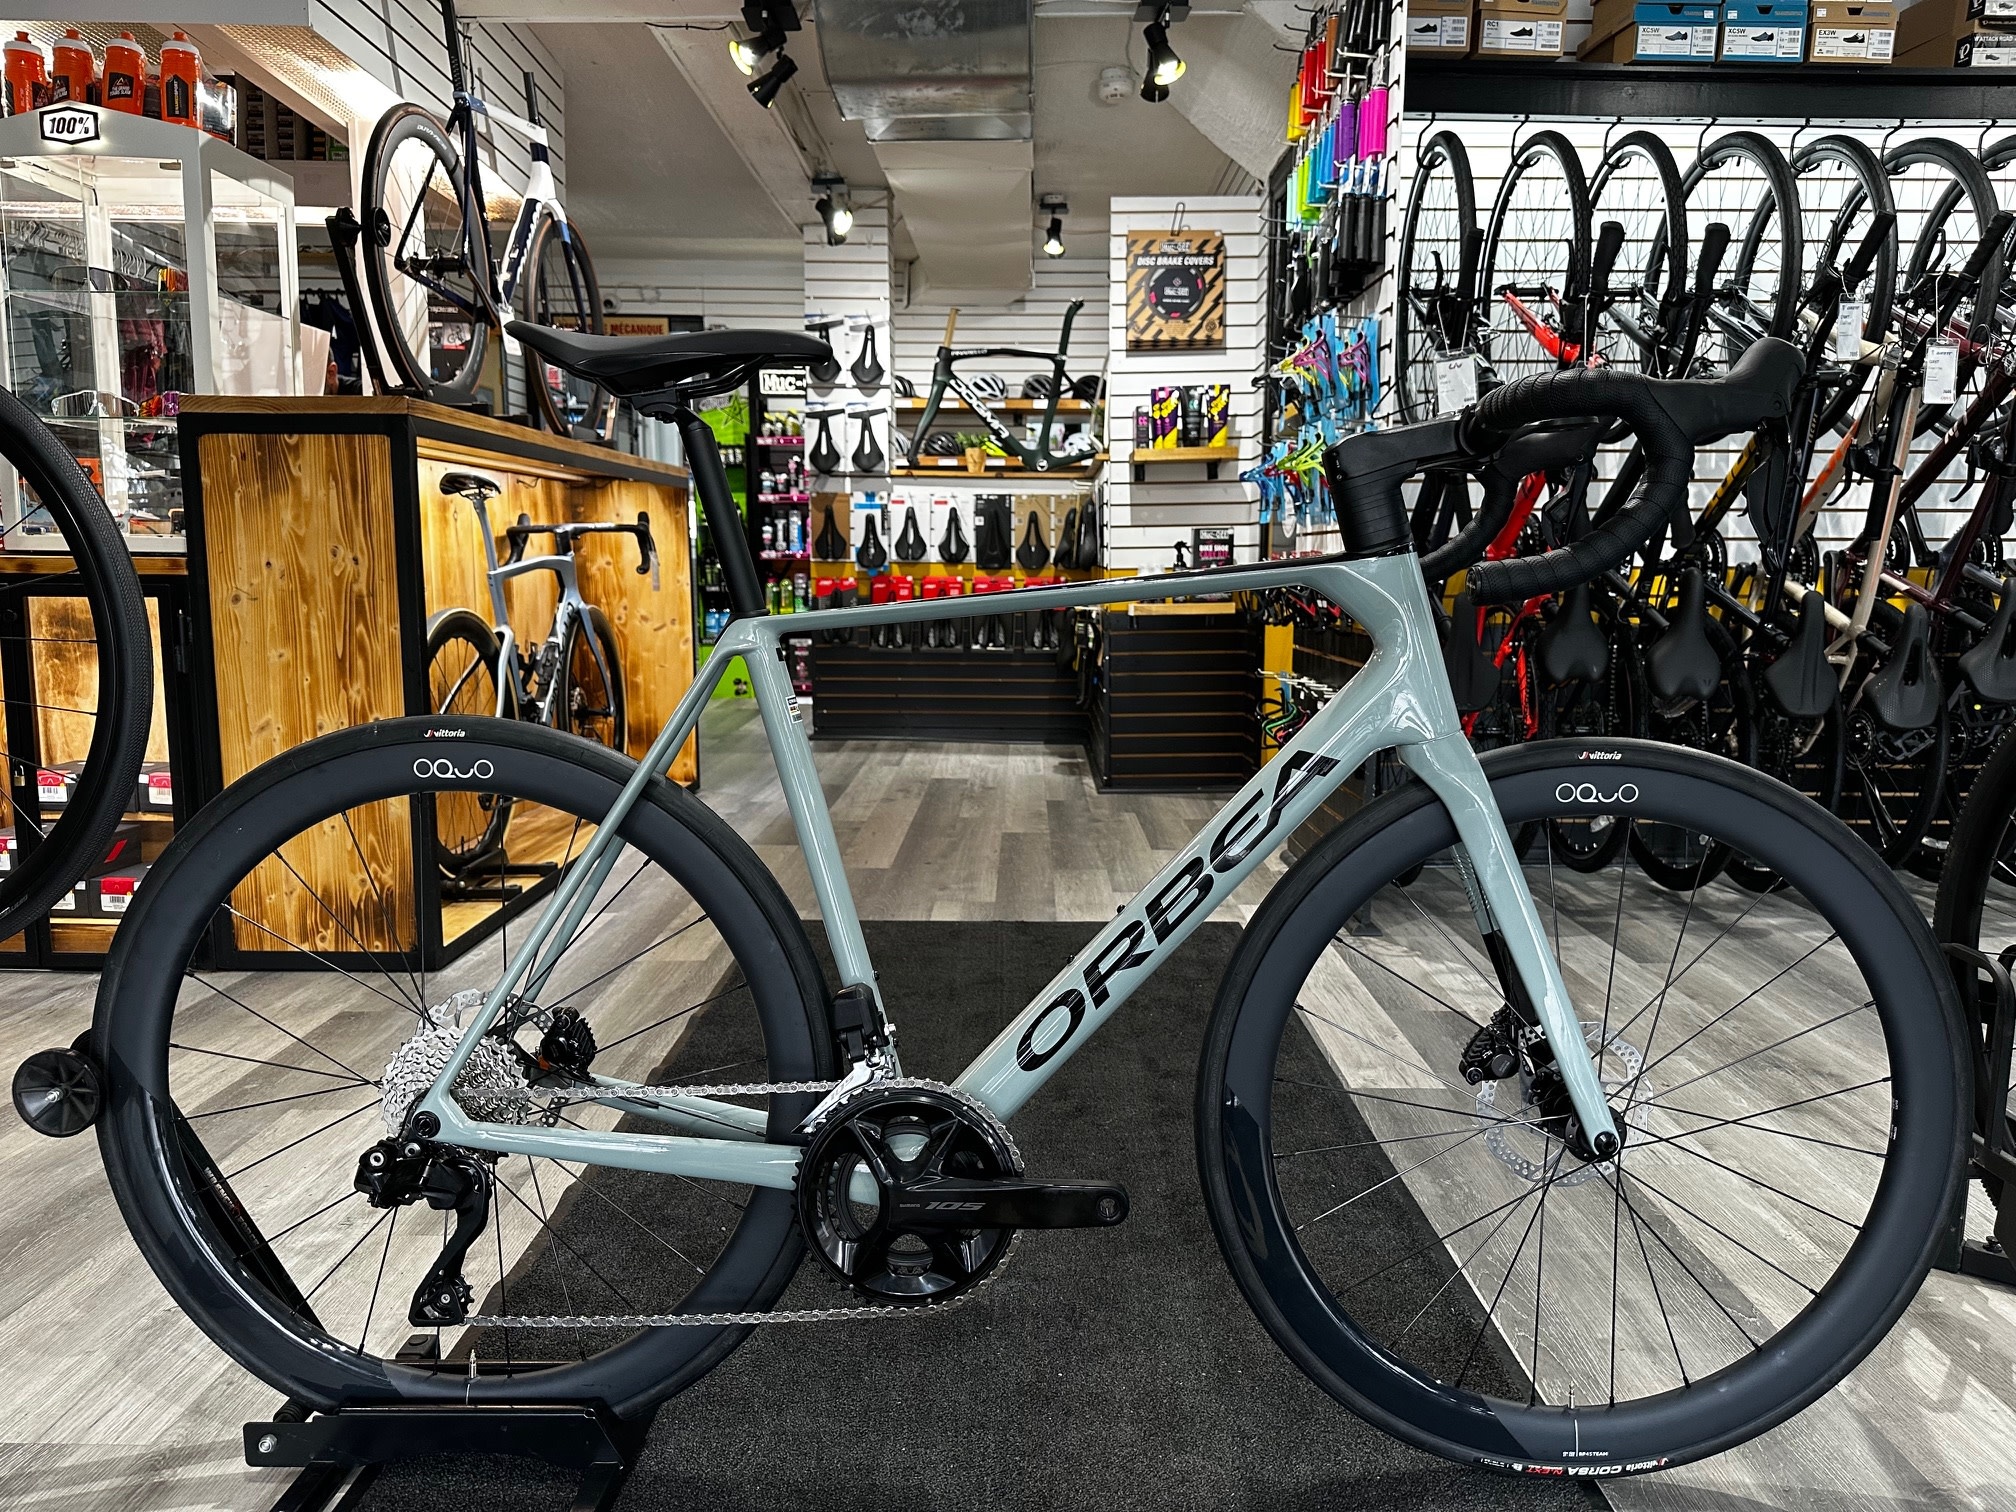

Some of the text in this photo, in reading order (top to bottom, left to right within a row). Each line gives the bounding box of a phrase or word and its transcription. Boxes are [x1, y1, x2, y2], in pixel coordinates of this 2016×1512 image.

[1486, 20, 1499, 28] RC1
[49, 116, 90, 135] 100%
[1137, 256, 1215, 266] DISC BRAKE COVERS
[610, 321, 664, 335] MÉCANIQUE
[764, 374, 806, 391] MUC-
[949, 378, 1010, 439] DOGMA
[434, 728, 466, 737] vittoria
[1589, 751, 1622, 760] vittoria
[1016, 749, 1342, 1072] ORBEA
[925, 1201, 986, 1211] 105
[1568, 1465, 1622, 1476] CORSA
